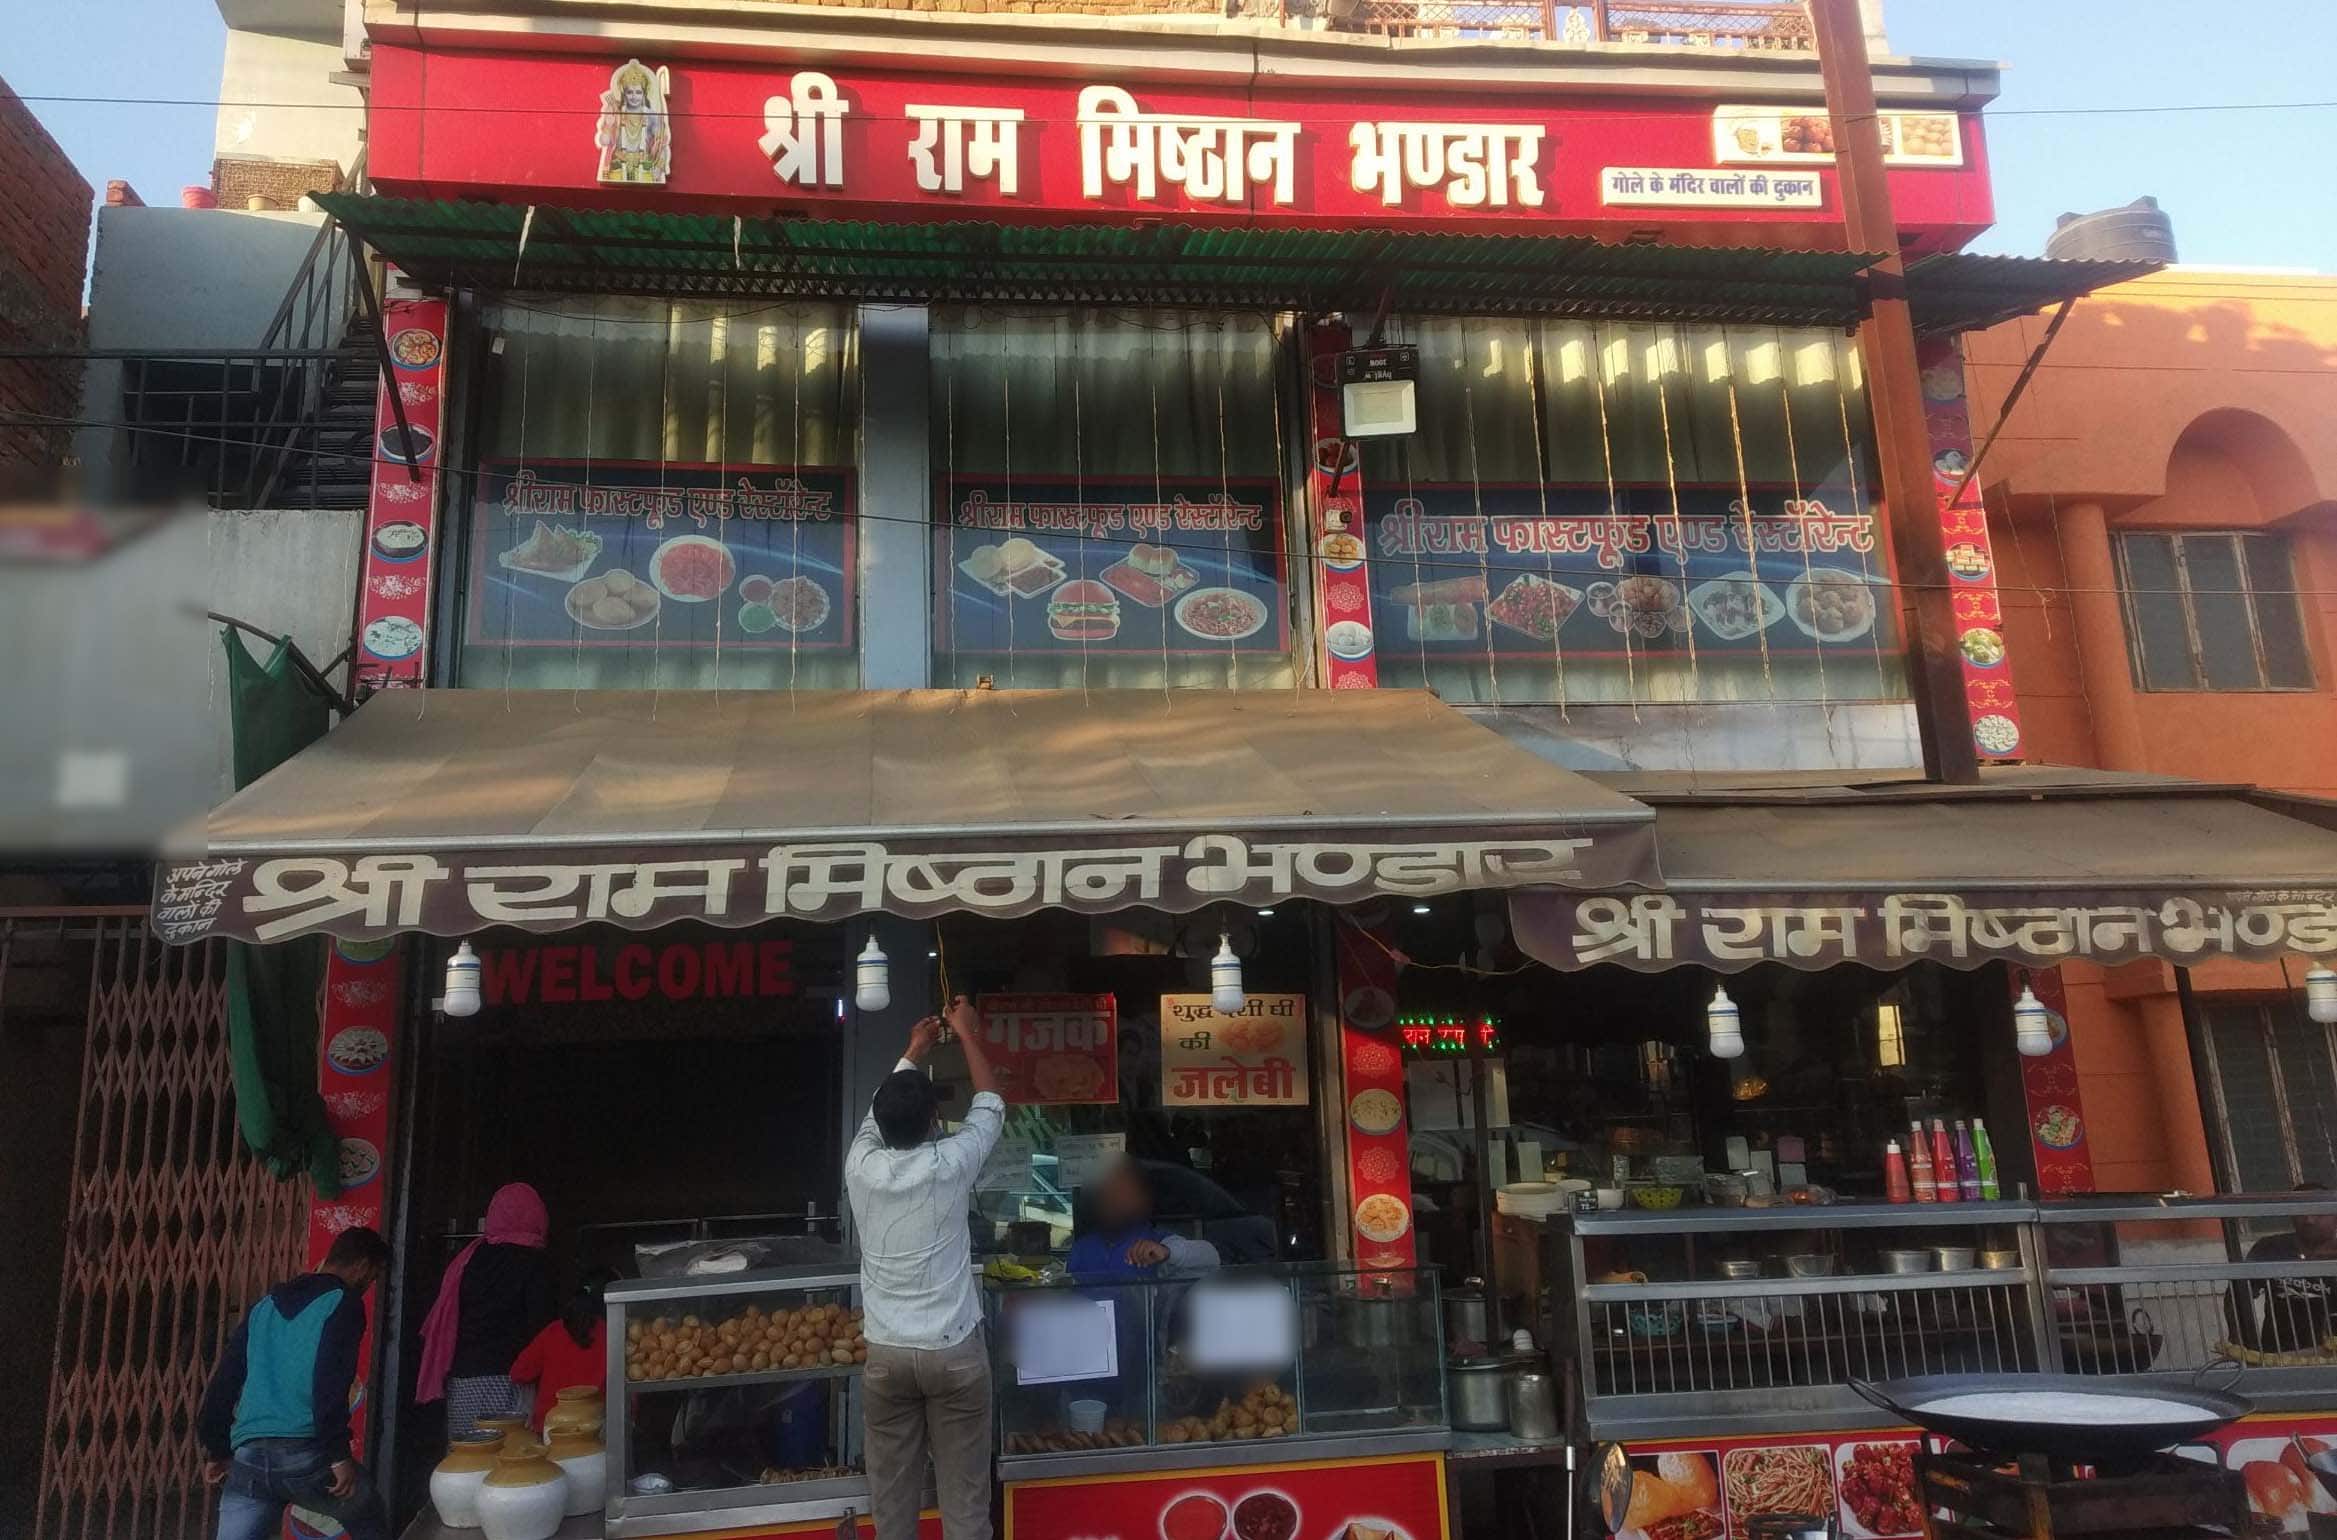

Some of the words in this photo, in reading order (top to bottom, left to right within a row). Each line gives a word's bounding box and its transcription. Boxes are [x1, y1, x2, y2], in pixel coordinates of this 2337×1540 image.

[757, 71, 849, 191] श्री
[904, 103, 1025, 194] राम
[1349, 120, 1546, 209] भण्डार
[1612, 171, 1645, 194] गोले
[1649, 172, 1664, 194] के
[1669, 172, 1705, 194] मंदिर
[1709, 173, 1746, 196] वालों
[1749, 174, 1769, 196] की
[1772, 178, 1814, 201] दुकान
[1127, 503, 1173, 540] एण्ड
[1652, 514, 1727, 566] एण्ड
[160, 883, 180, 904] के
[200, 898, 223, 917] की
[242, 854, 450, 943] श्री
[464, 858, 747, 922] राम
[1183, 834, 1594, 896] भण्डार
[1572, 894, 1687, 963] श्री
[1700, 906, 1866, 959] राम
[481, 940, 797, 1007] WELCOME
[983, 1010, 1112, 1054] गजक
[1172, 1003, 1214, 1023] शुद्ध
[1217, 998, 1264, 1018] शी
[1269, 998, 1296, 1017] घी
[1177, 1030, 1216, 1051] की
[1171, 1055, 1297, 1100] जलेबी
